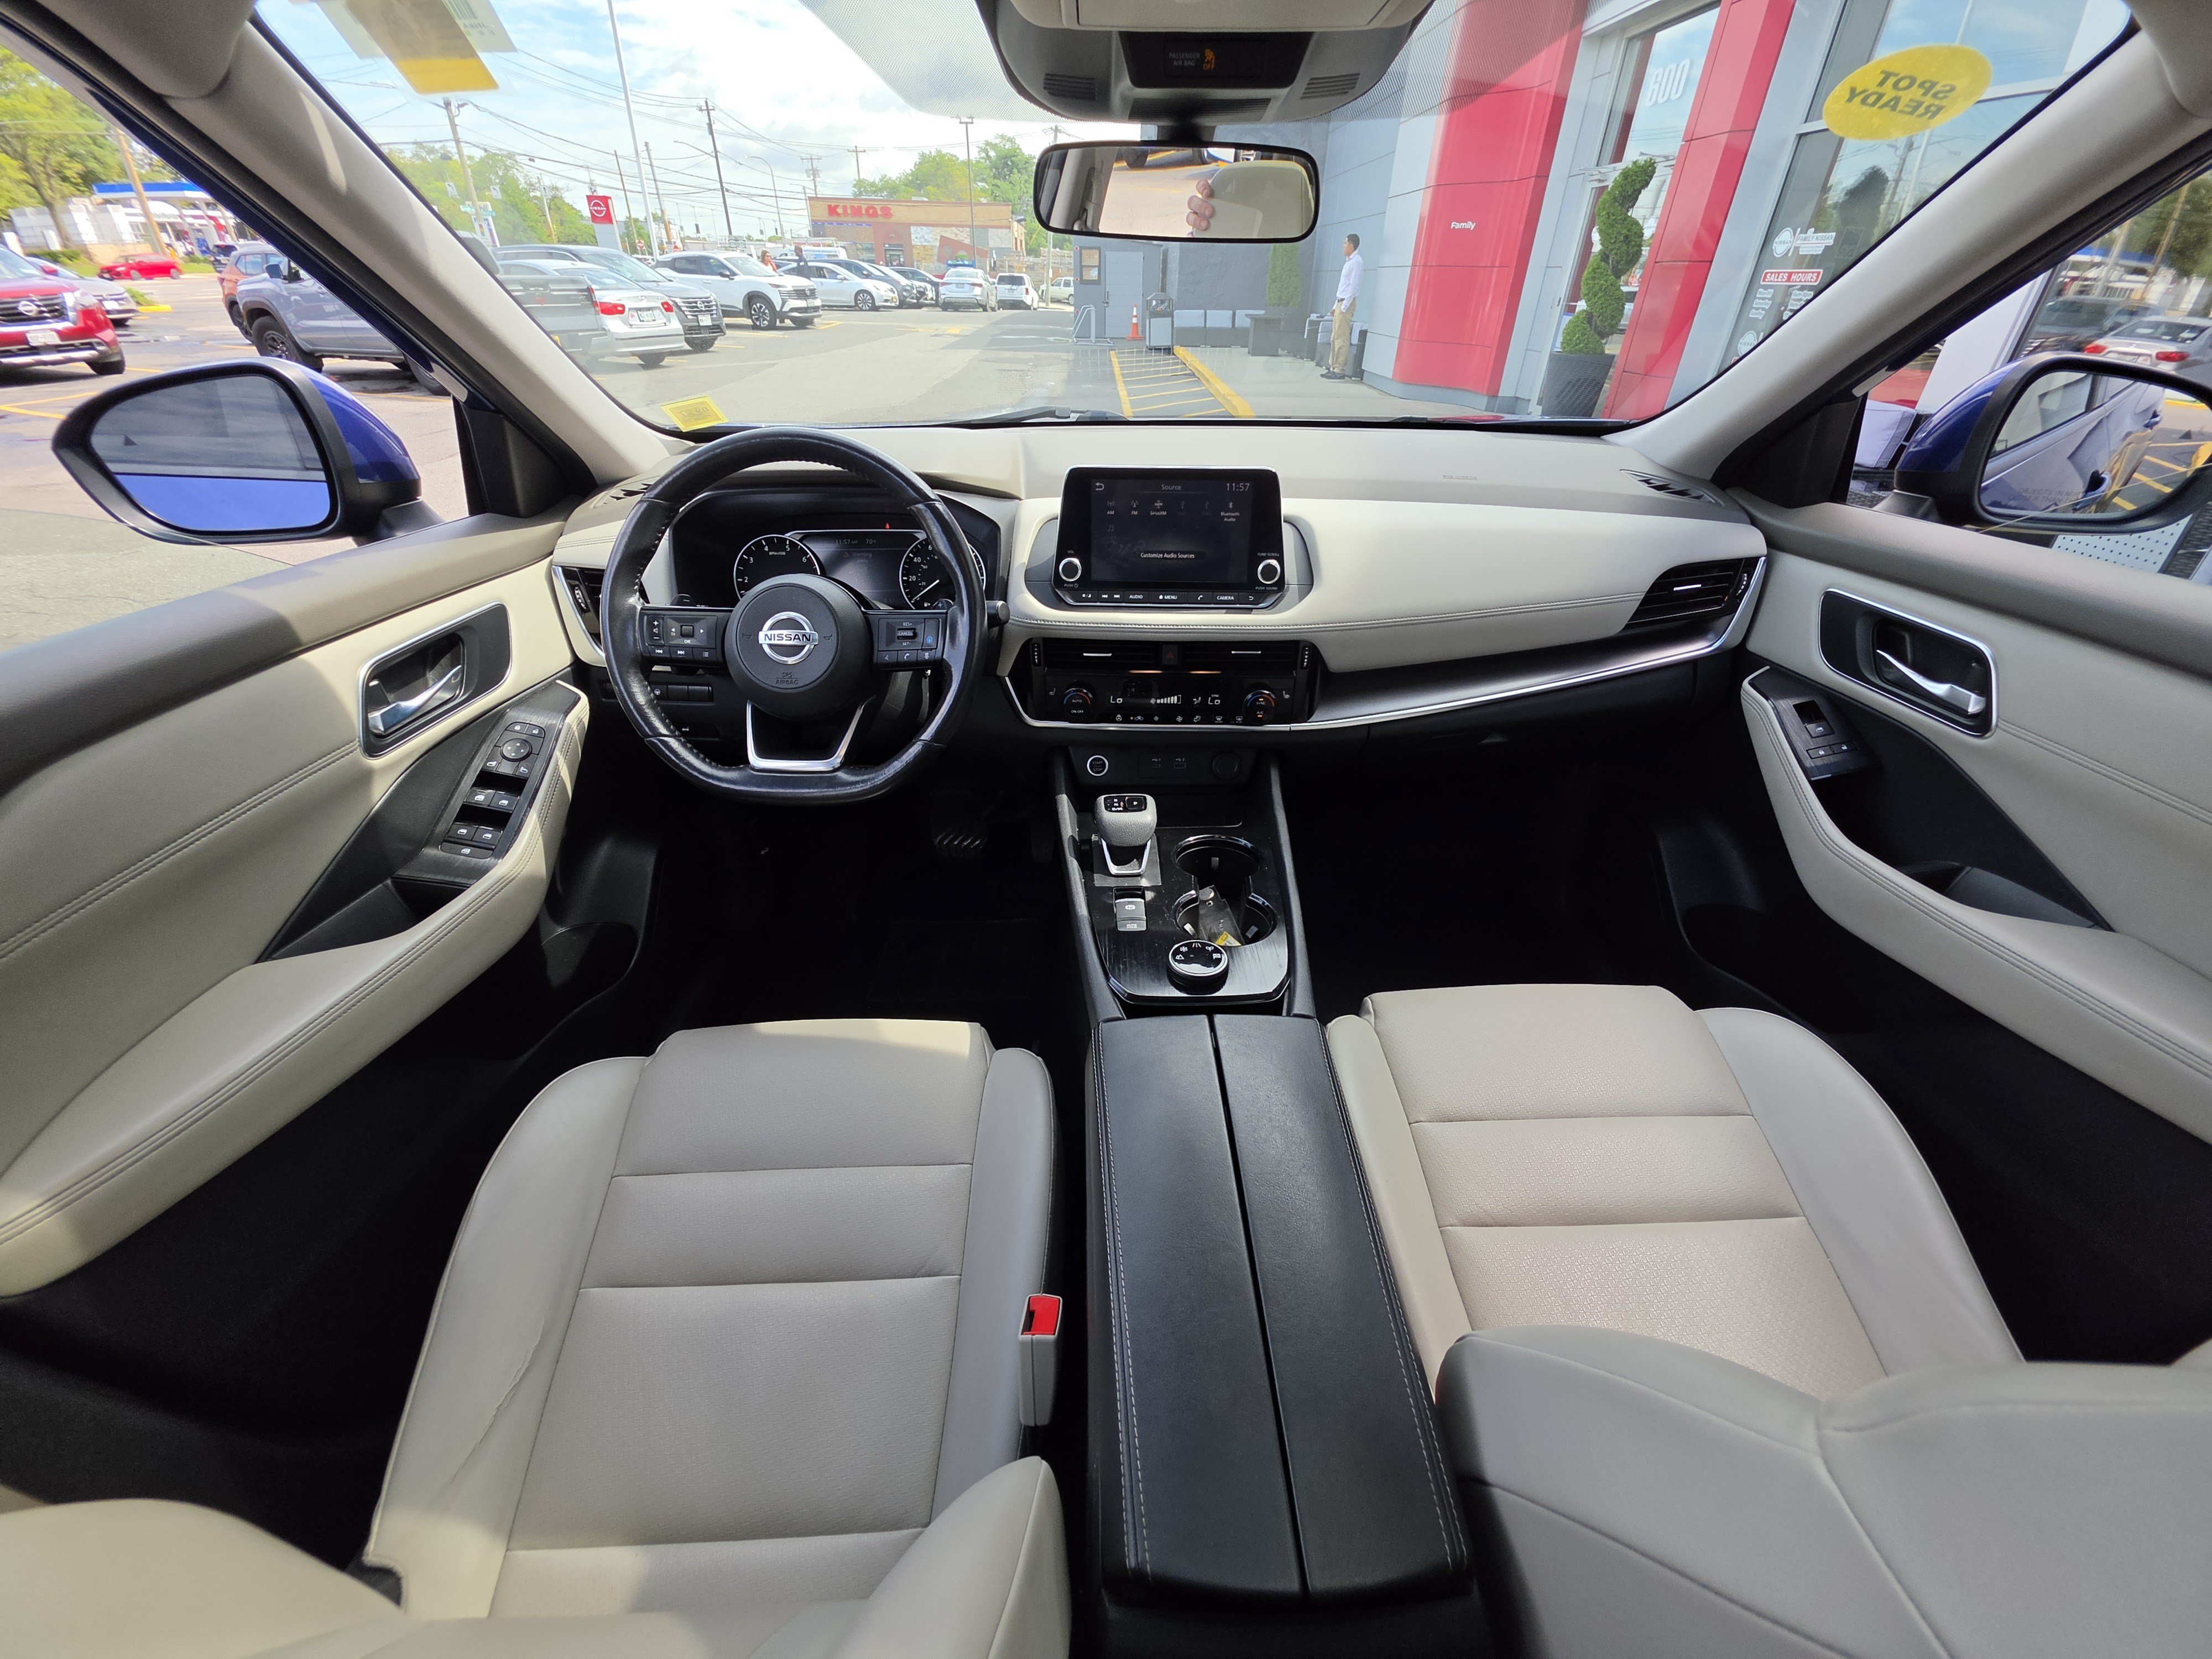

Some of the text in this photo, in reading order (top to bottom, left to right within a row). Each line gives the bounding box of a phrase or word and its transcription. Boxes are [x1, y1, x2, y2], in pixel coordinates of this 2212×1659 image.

[1645, 59, 1690, 106] 600
[827, 204, 893, 219] KINGS
[1451, 221, 1476, 231] Family
[1815, 233, 1834, 241] NISSAN
[1765, 273, 1818, 282] SALES HOURS
[1226, 483, 1250, 491] 11:57
[764, 633, 811, 642] NISSAN
